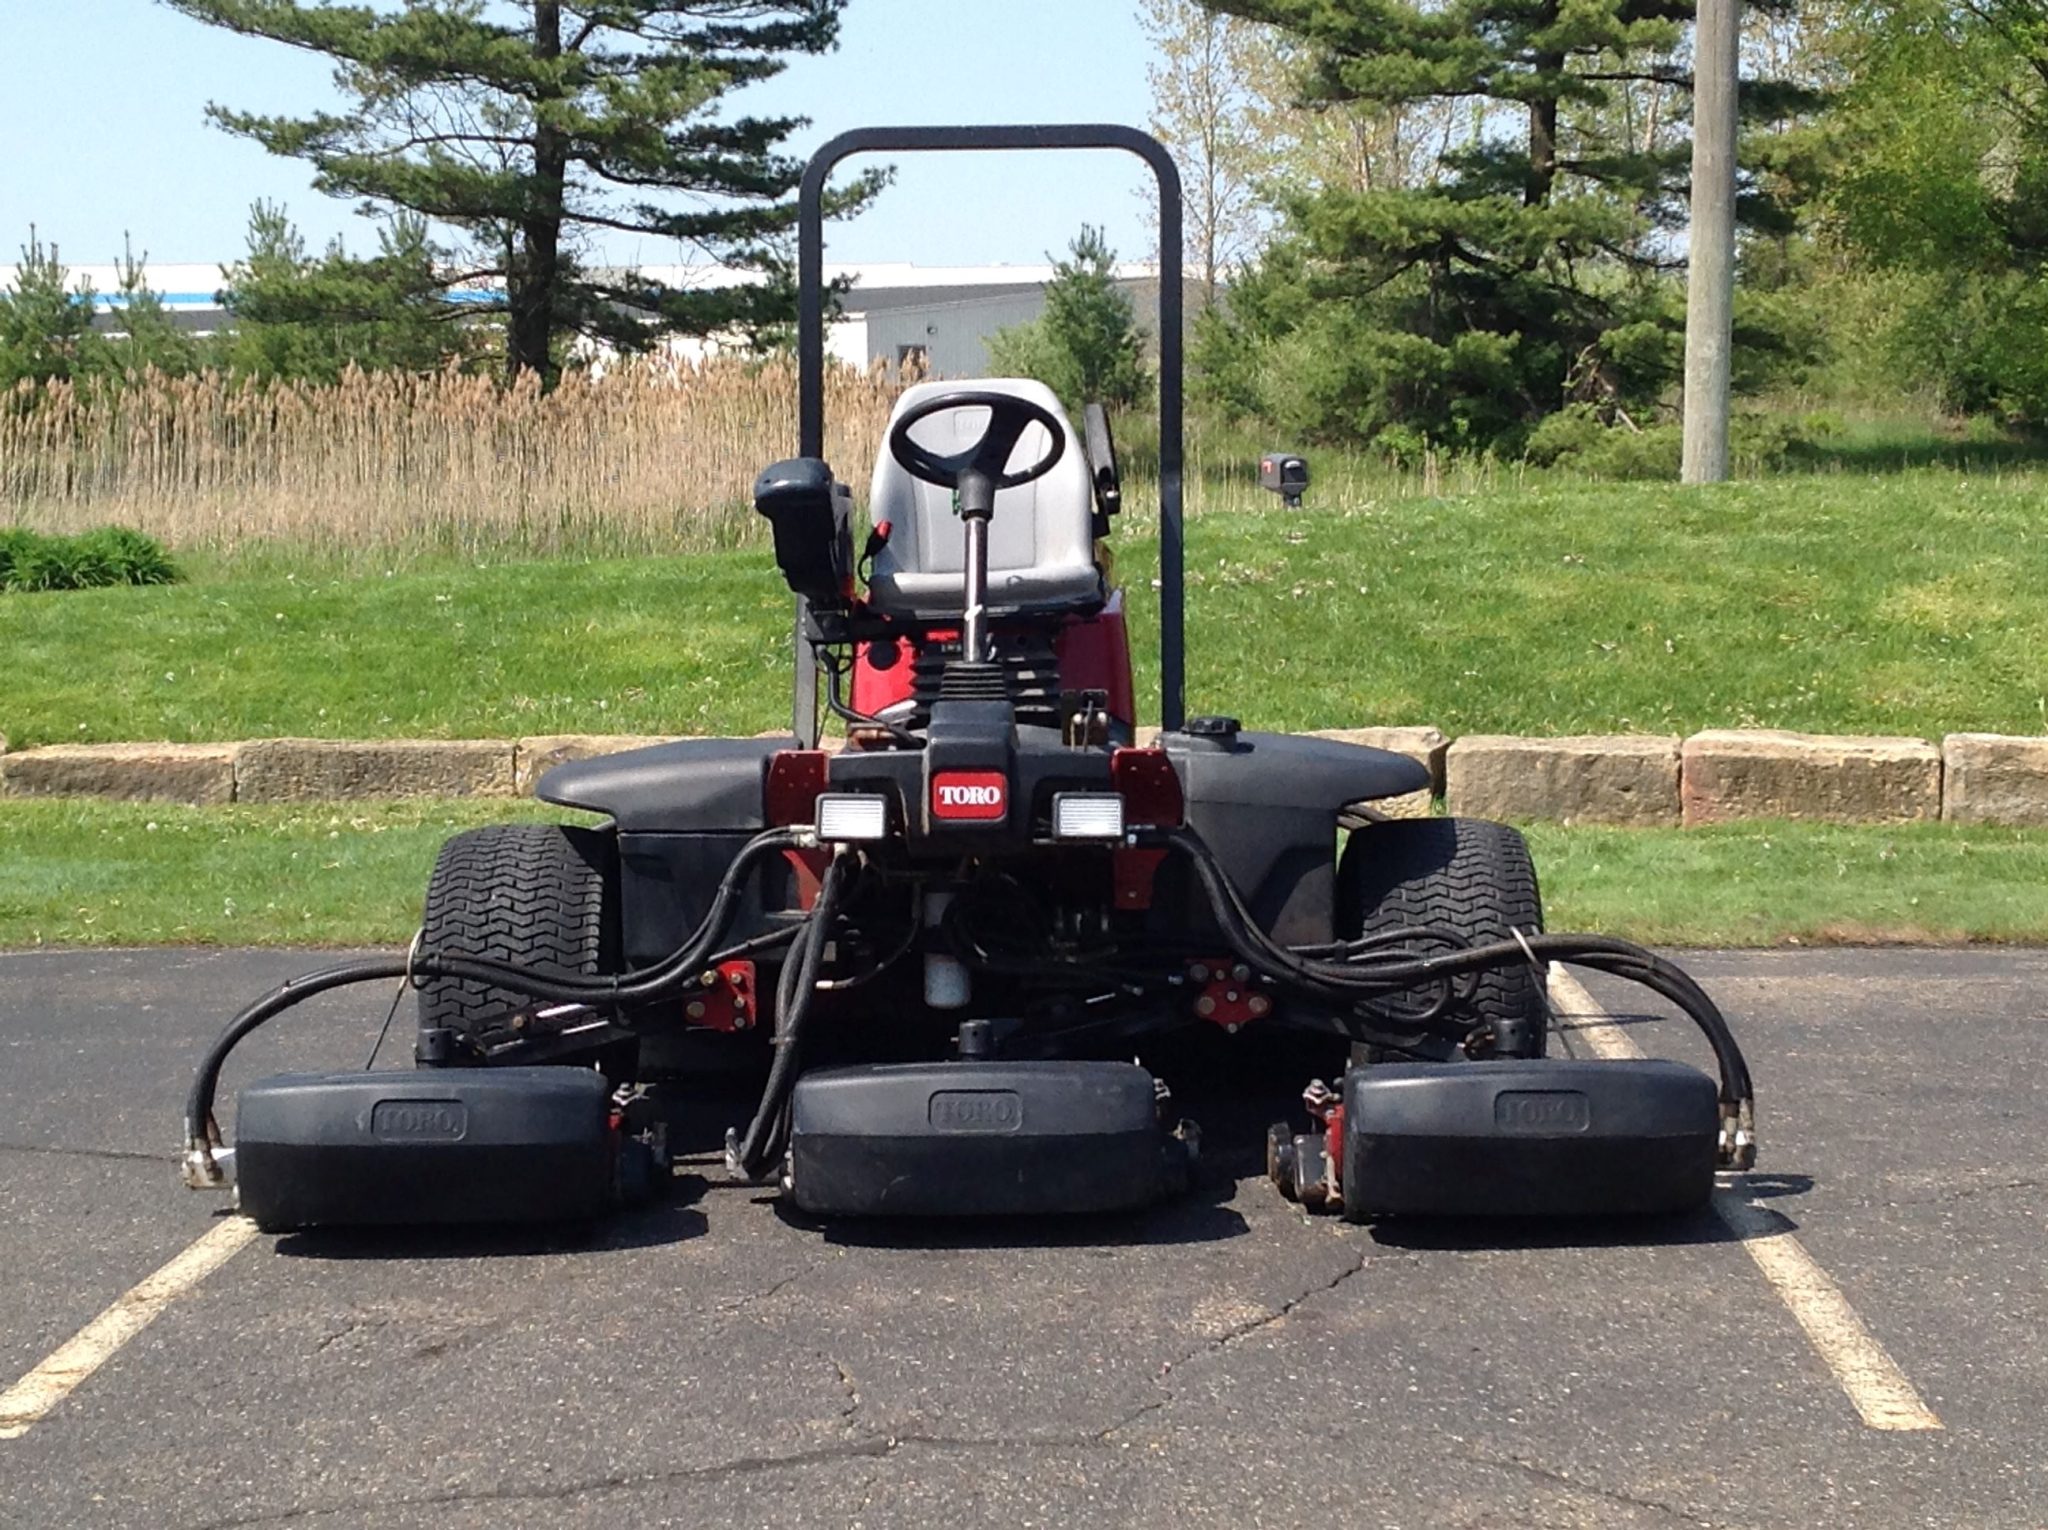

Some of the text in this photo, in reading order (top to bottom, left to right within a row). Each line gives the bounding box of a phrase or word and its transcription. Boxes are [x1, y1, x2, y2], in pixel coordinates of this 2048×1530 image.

[939, 786, 1001, 805] TORO
[377, 1107, 459, 1132] TORO
[934, 1099, 1014, 1123] TORO
